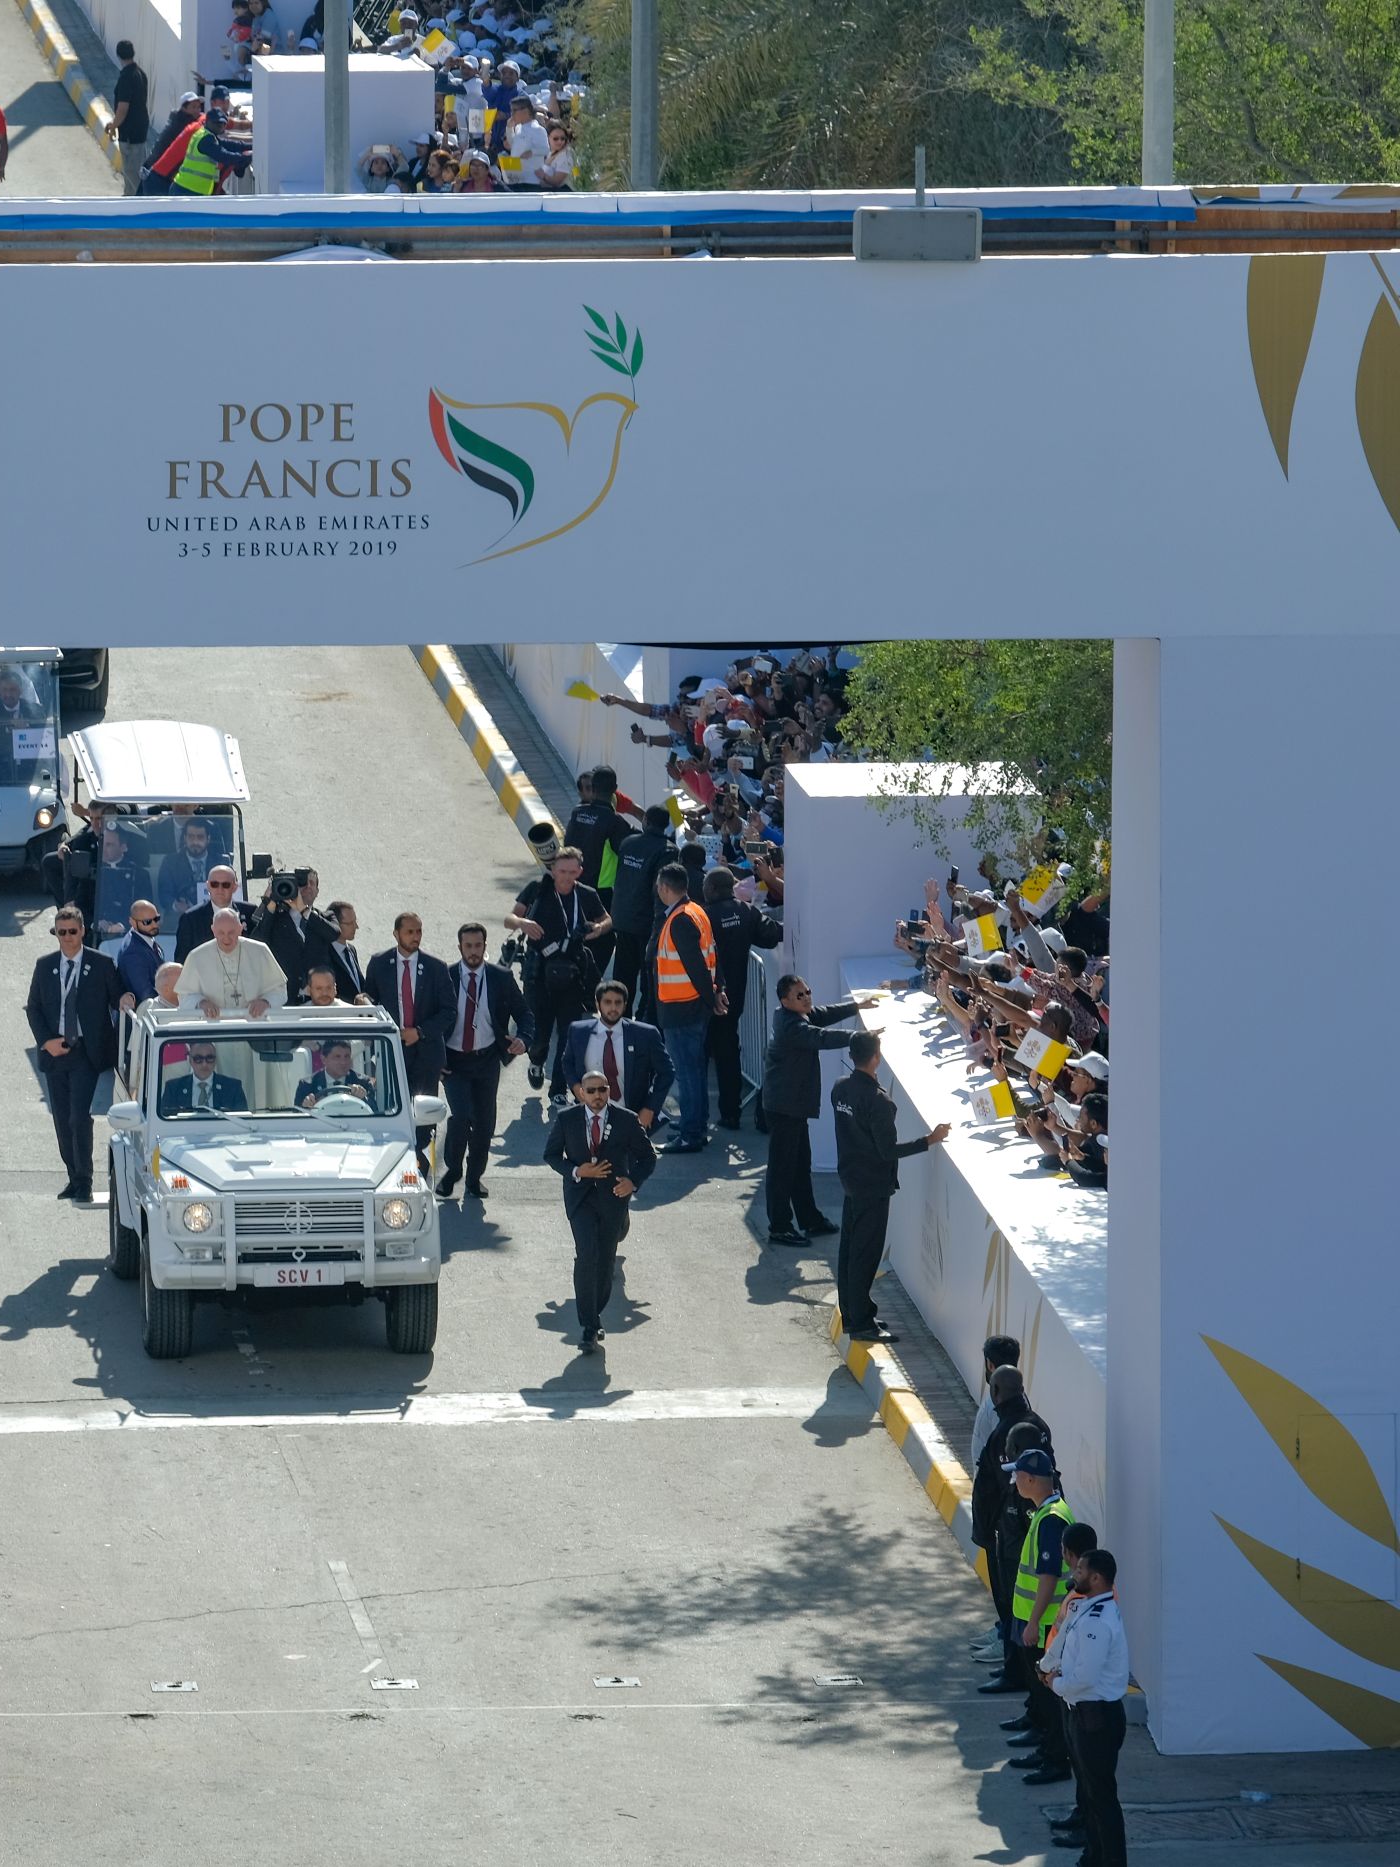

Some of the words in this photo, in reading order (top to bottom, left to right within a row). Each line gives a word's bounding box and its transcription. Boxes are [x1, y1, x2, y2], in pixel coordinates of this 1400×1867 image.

[218, 402, 356, 444] POPE
[165, 457, 413, 500] FRANCIS
[146, 516, 239, 533] UNITED
[248, 515, 307, 531] ARAB
[318, 513, 431, 531] EMIRATES
[177, 543, 212, 559] 3-5
[223, 541, 341, 558] FEBRUARY
[348, 540, 398, 556] 2019
[277, 1268, 309, 1284] SCV
[316, 1268, 323, 1284] 1
